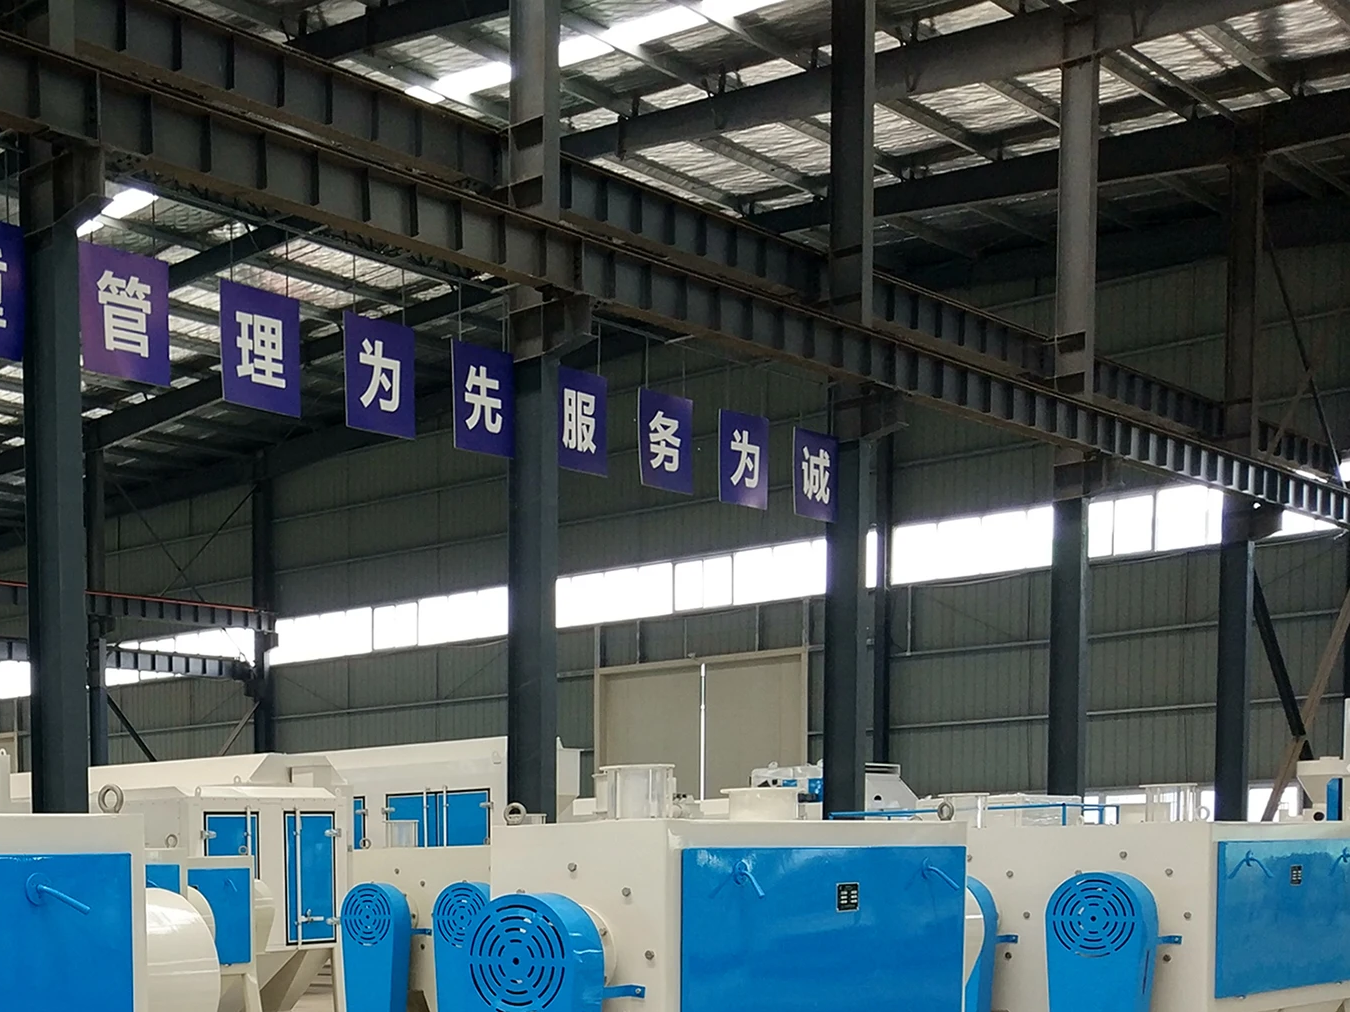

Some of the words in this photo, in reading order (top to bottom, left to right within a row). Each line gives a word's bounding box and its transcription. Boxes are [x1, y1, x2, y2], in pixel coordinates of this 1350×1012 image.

[96, 269, 152, 358] 管
[235, 310, 287, 389] 理
[359, 339, 401, 412] 为
[464, 365, 502, 434] 先
[562, 388, 596, 454] 服
[648, 410, 682, 473] 务
[730, 429, 760, 489] 为
[801, 445, 830, 505] 诚
